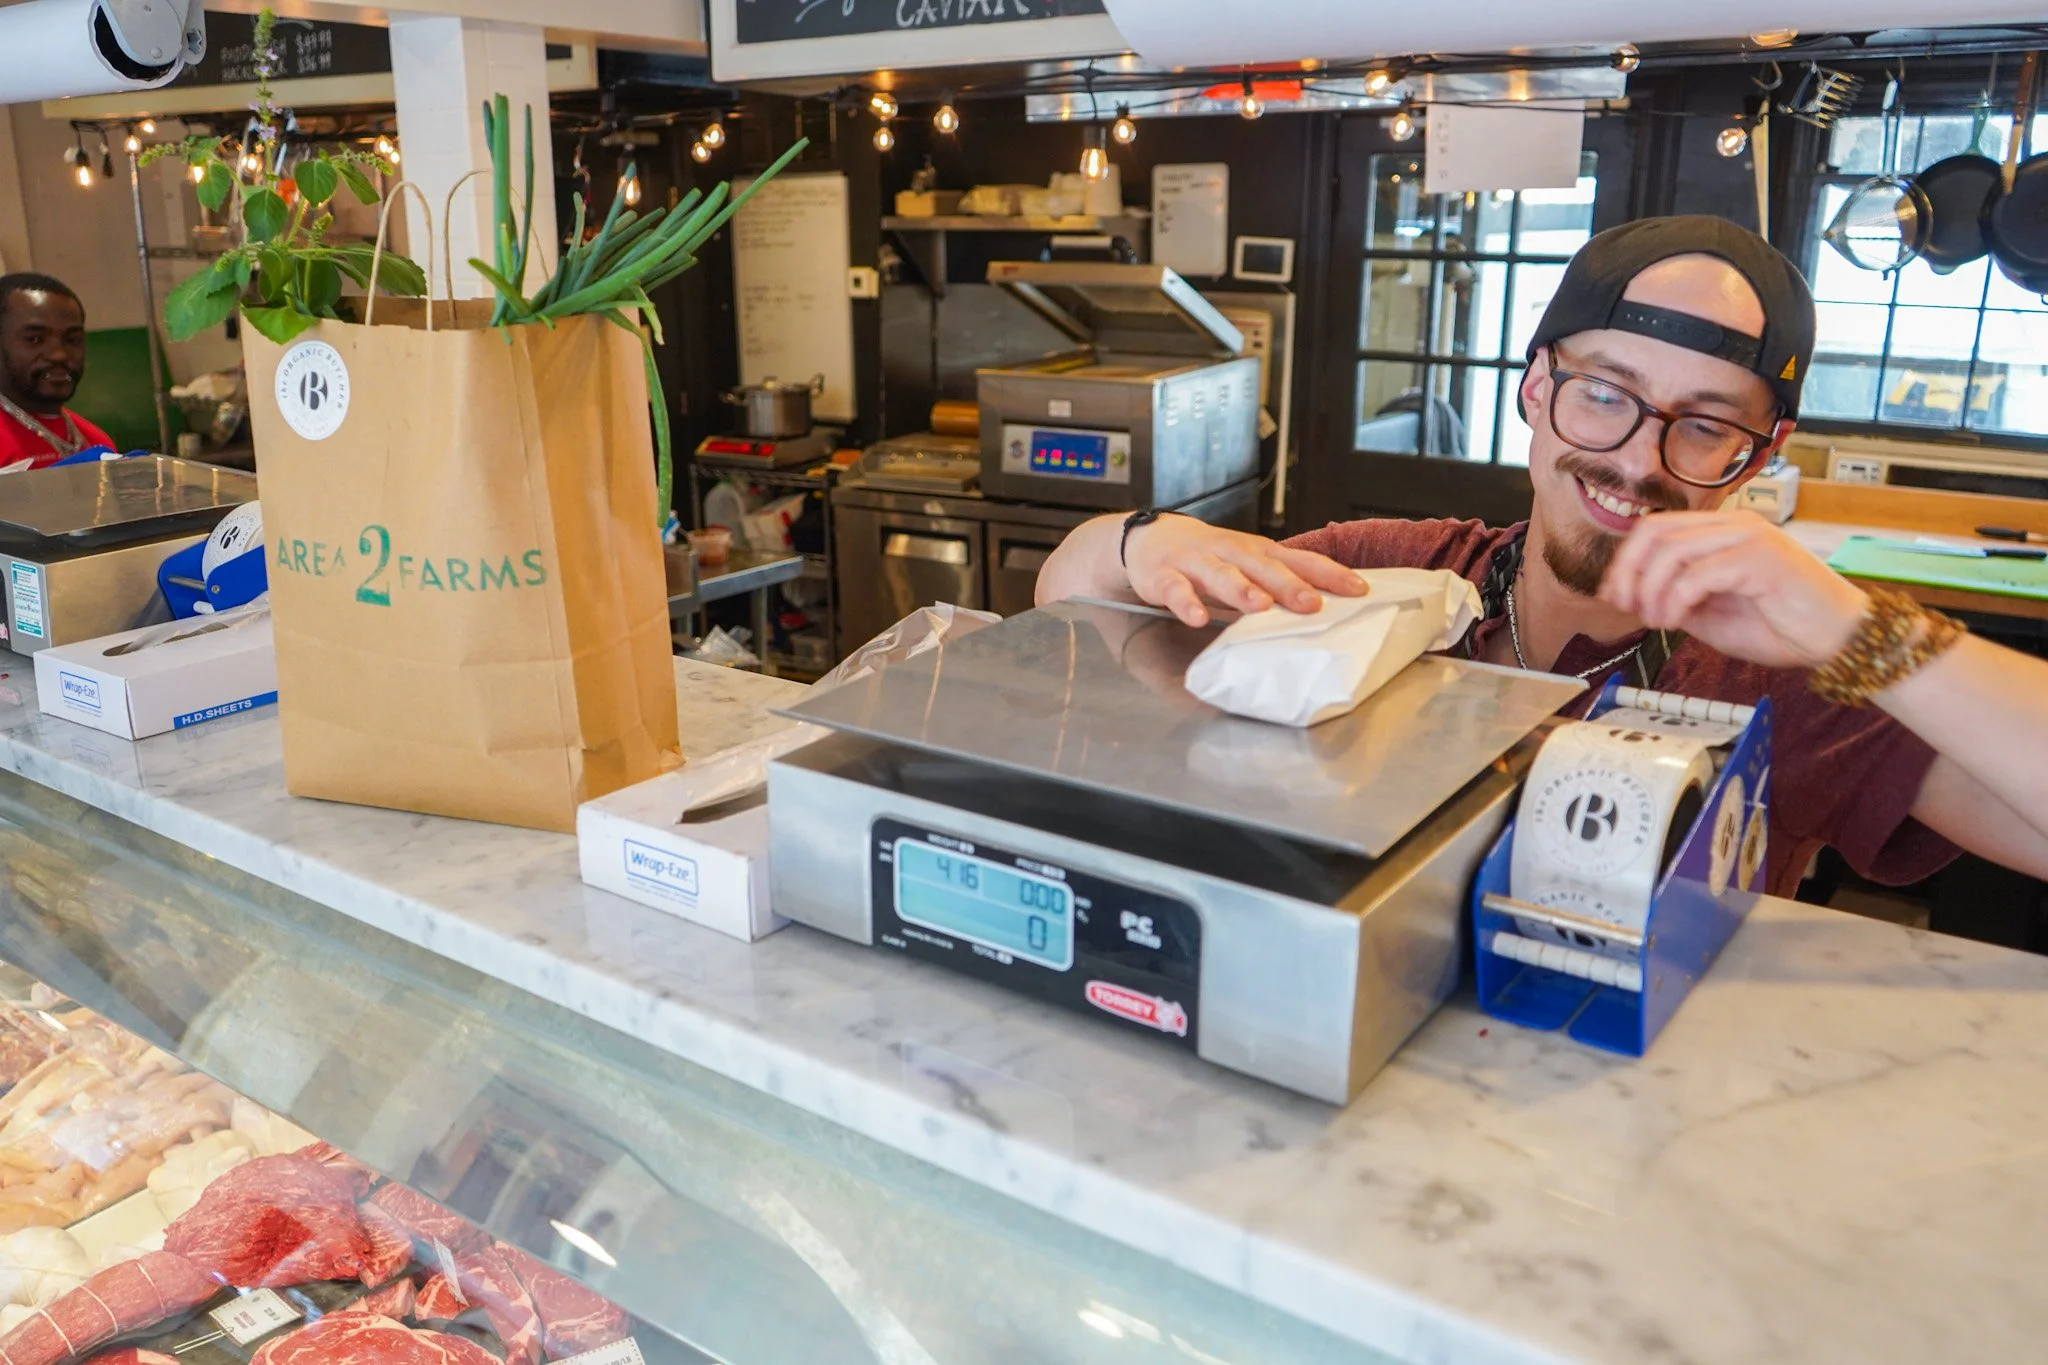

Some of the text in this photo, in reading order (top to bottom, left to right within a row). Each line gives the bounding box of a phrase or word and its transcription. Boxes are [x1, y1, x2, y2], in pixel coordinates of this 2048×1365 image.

[276, 537, 348, 577] AREA
[355, 524, 391, 607] 2
[398, 549, 548, 593] FARMS
[182, 699, 253, 725] H.D.SHEETS
